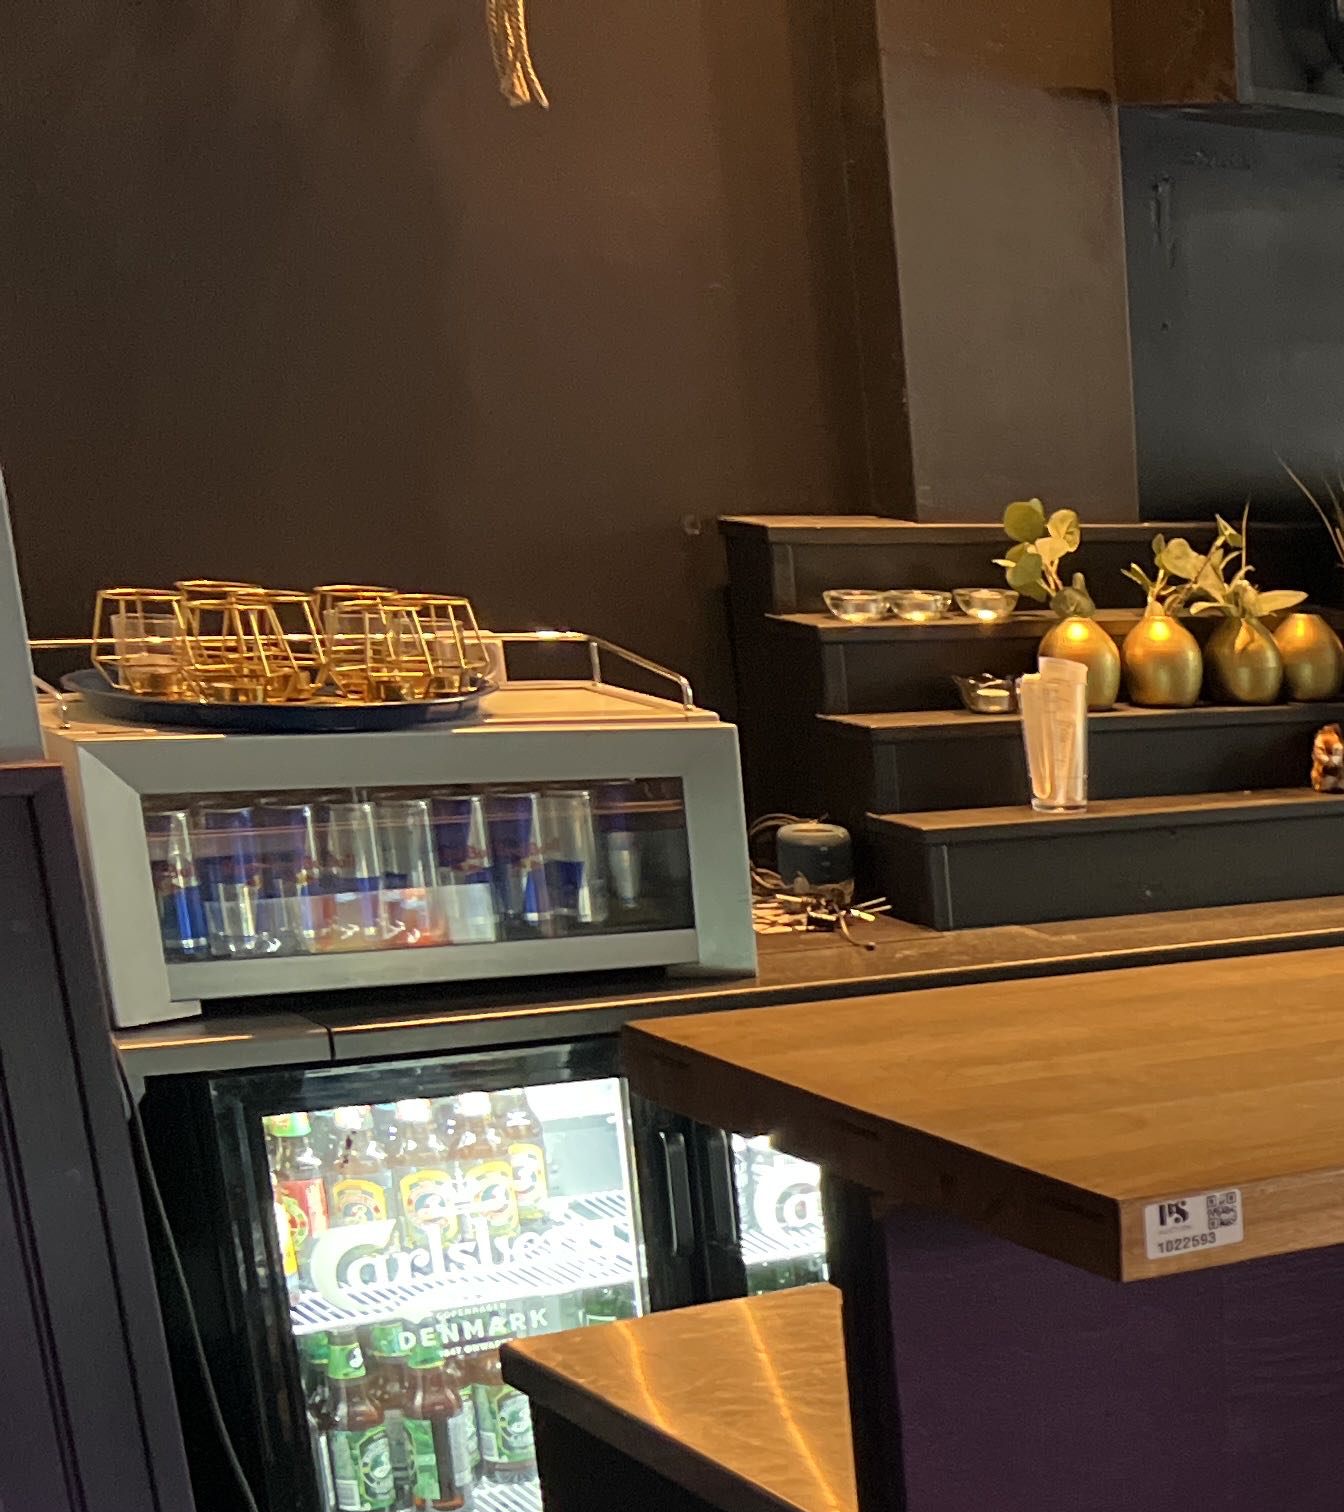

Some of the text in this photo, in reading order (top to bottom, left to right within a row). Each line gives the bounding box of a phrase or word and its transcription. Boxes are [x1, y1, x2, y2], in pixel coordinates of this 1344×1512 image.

[1158, 1232, 1217, 1253] 1022593
[312, 1213, 616, 1318] Carlsbe
[398, 1308, 549, 1351] DENMARK
